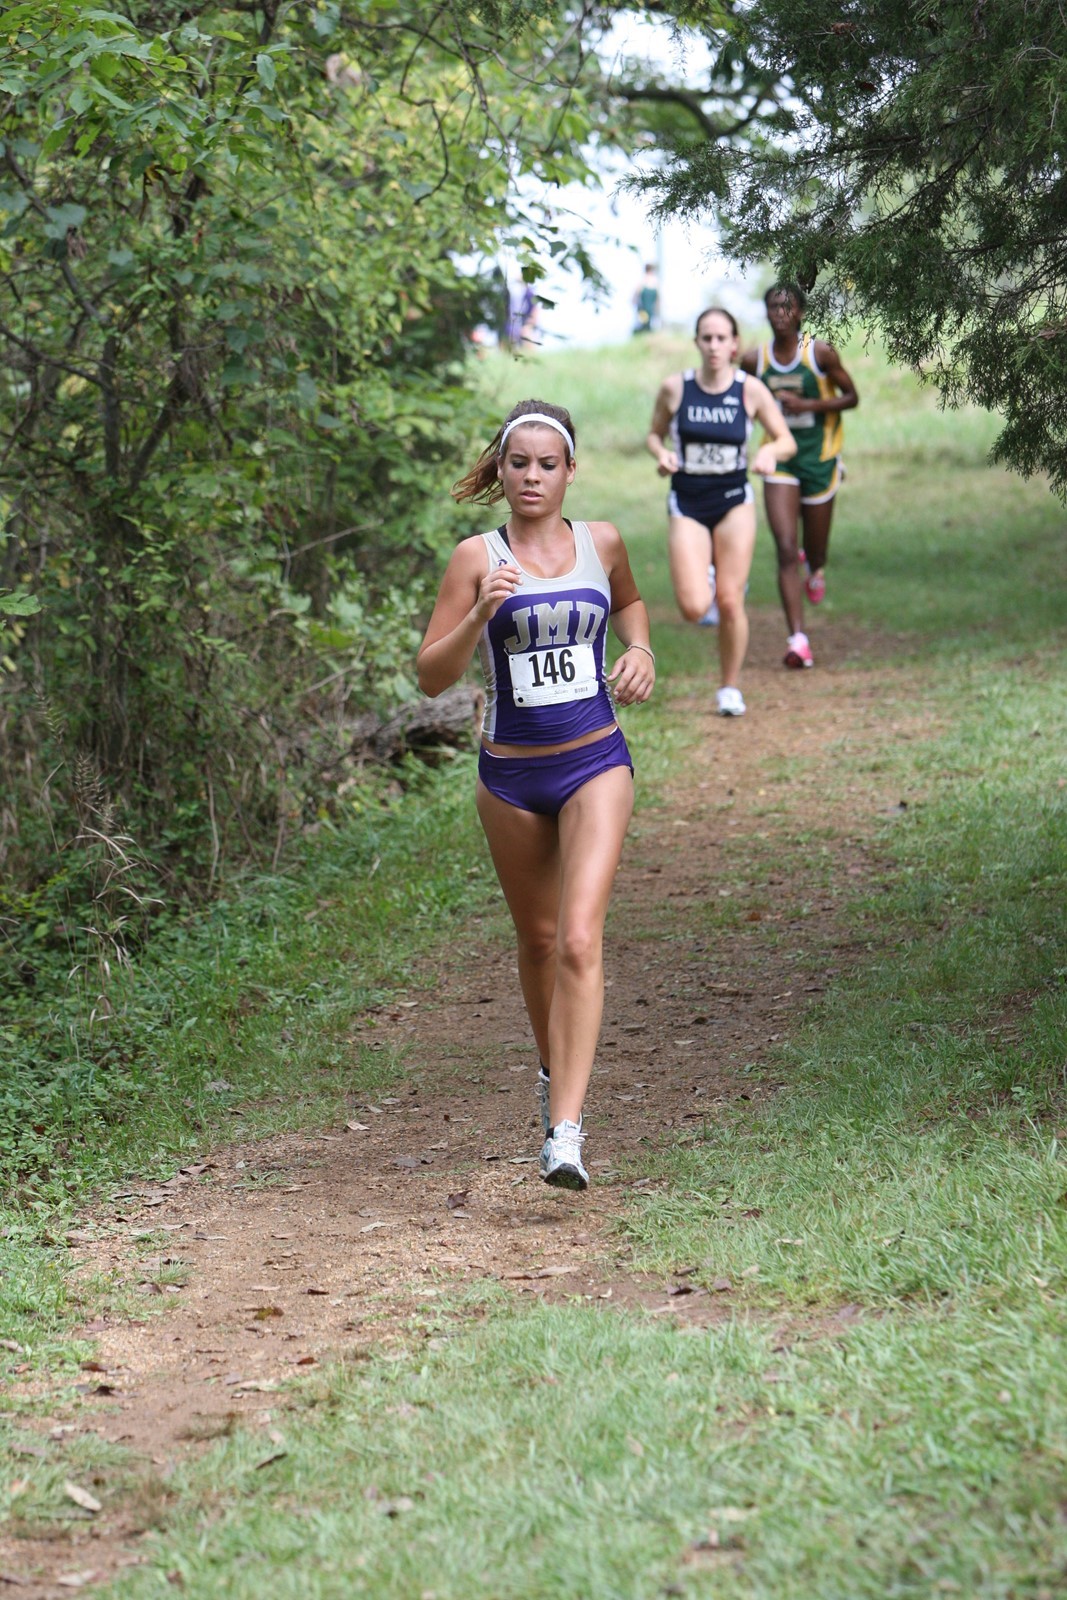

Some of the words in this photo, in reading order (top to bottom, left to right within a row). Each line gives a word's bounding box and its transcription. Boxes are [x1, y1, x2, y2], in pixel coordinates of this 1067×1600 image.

[687, 405, 739, 424] UMW
[504, 601, 605, 653] JMU
[528, 649, 576, 688] 146
